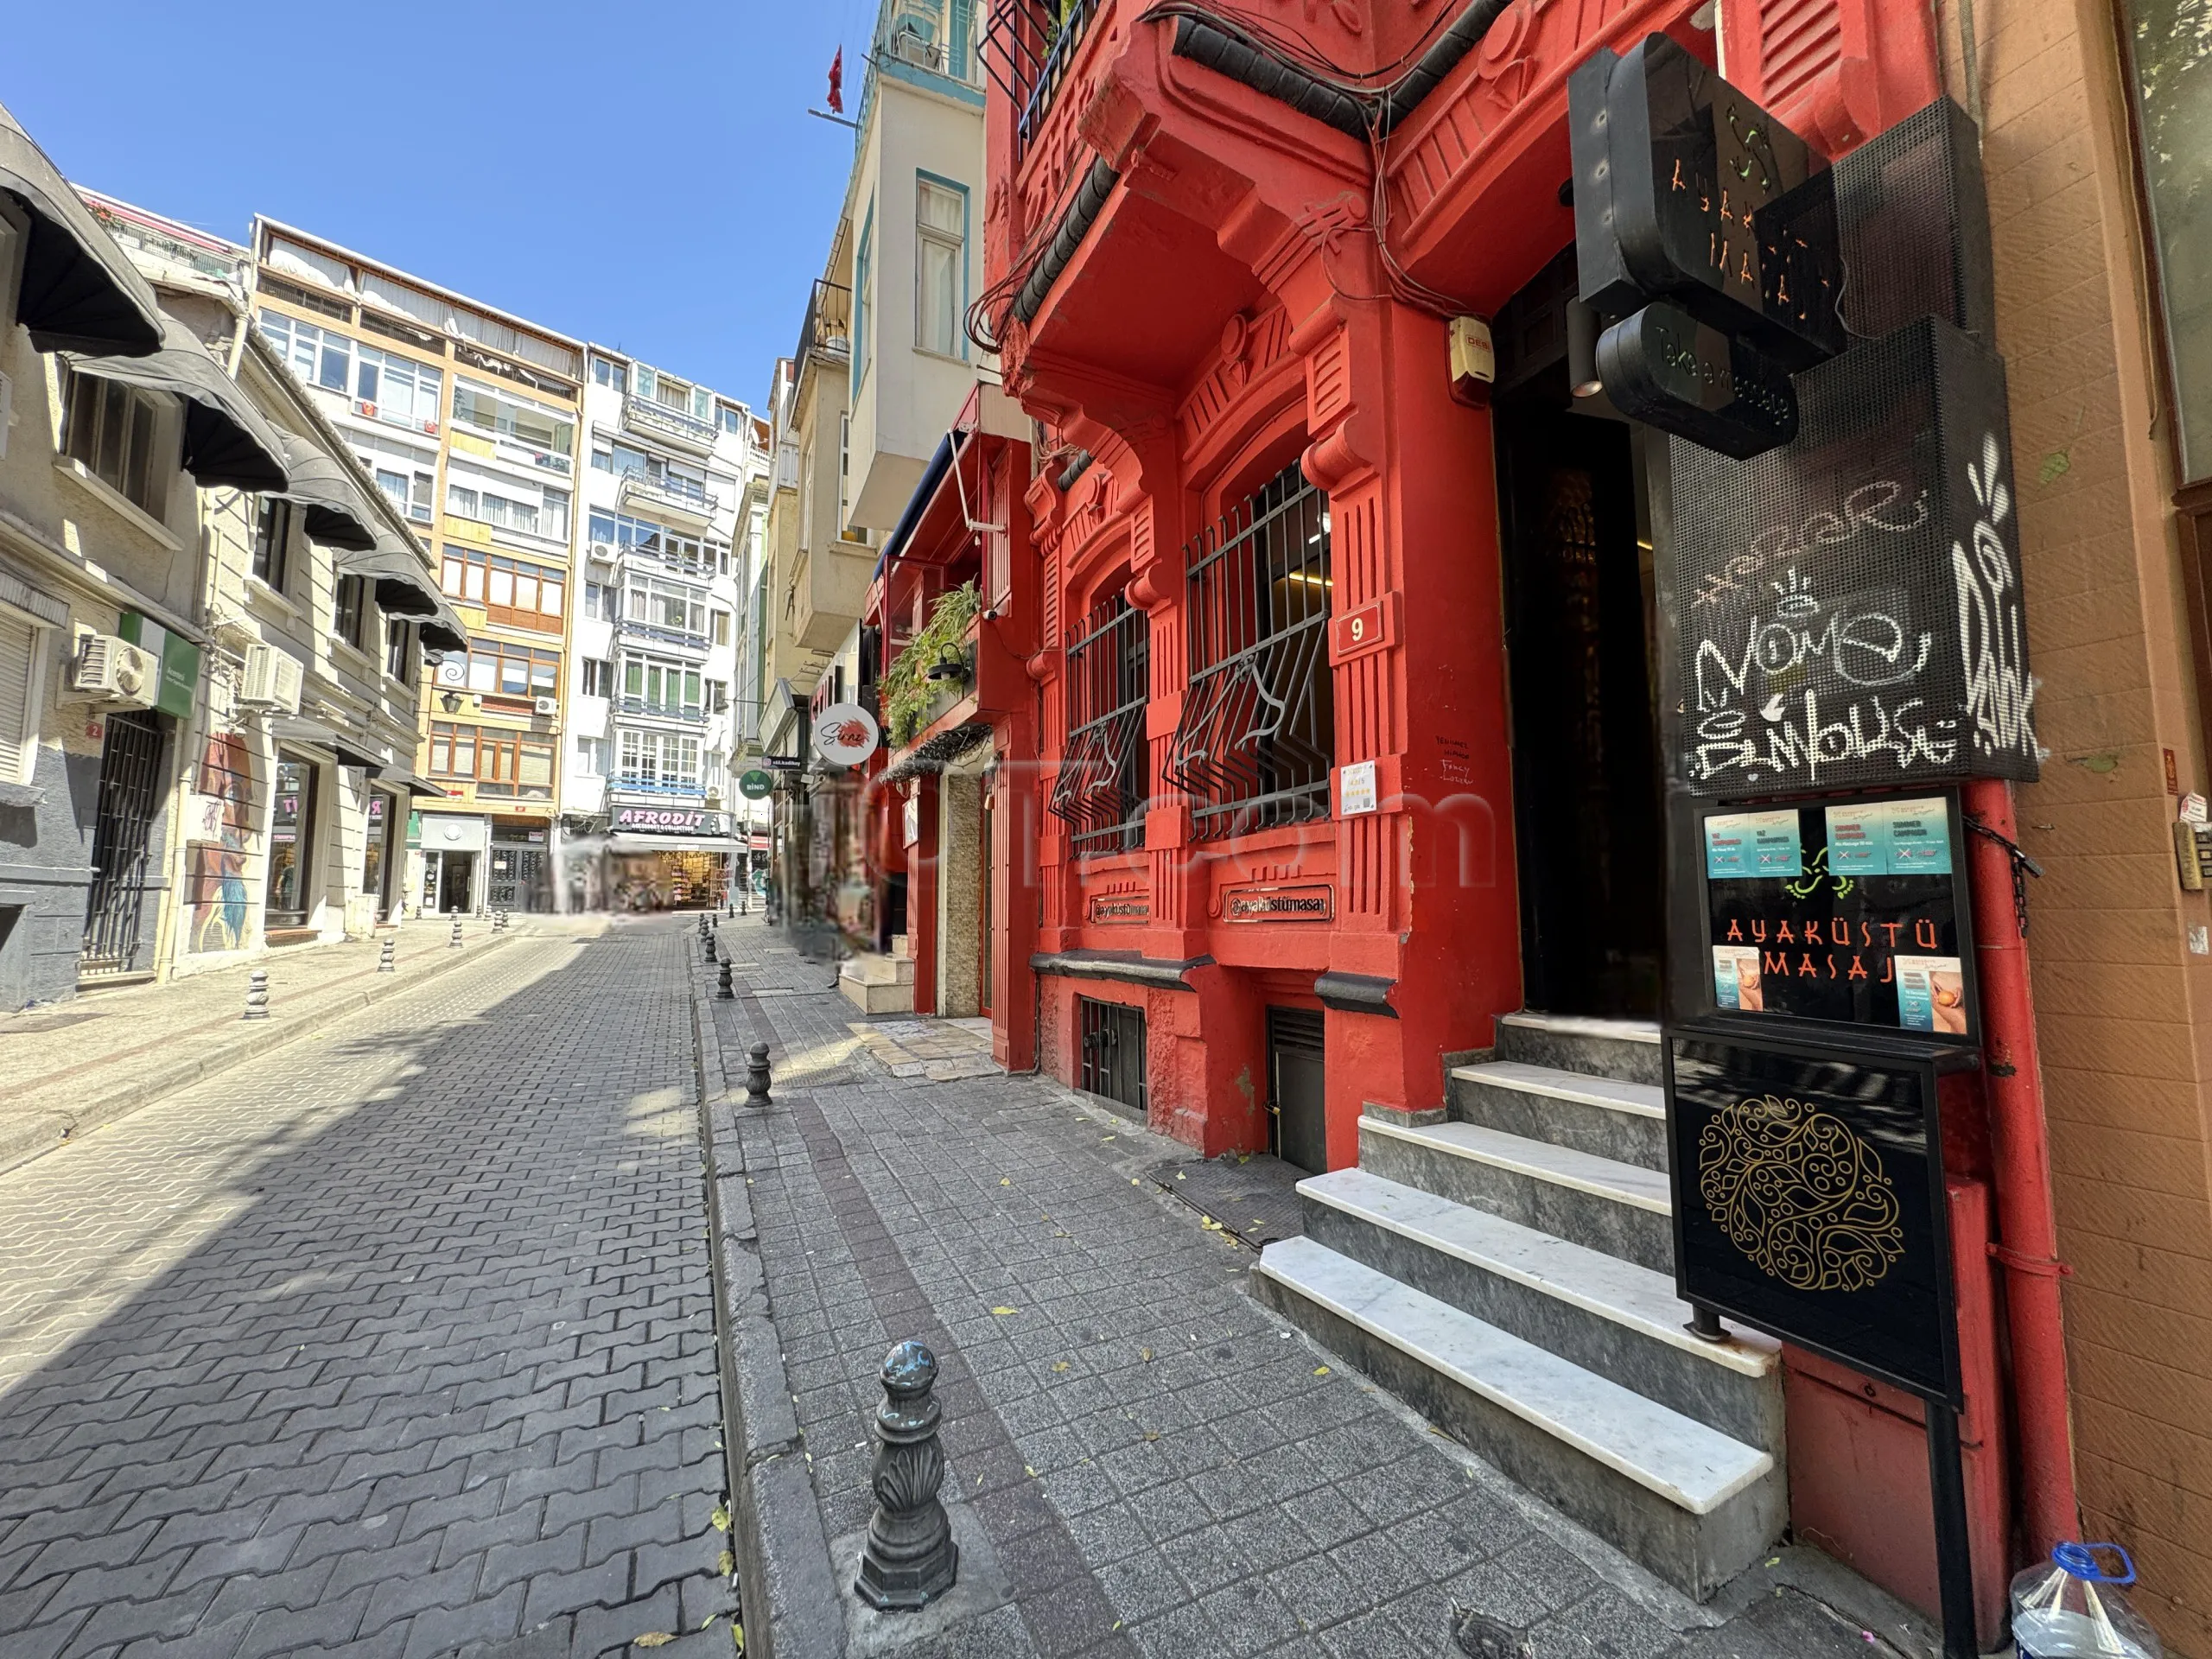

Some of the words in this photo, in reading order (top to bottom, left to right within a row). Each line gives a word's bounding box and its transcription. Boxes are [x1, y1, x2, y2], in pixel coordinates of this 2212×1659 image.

[1351, 617, 1364, 642] 9
[92, 725, 99, 737] 2
[619, 809, 706, 827] AFRODİT
[1726, 917, 1938, 950] AYAKÜSTÜ
[1764, 950, 1894, 983] MASAJ
